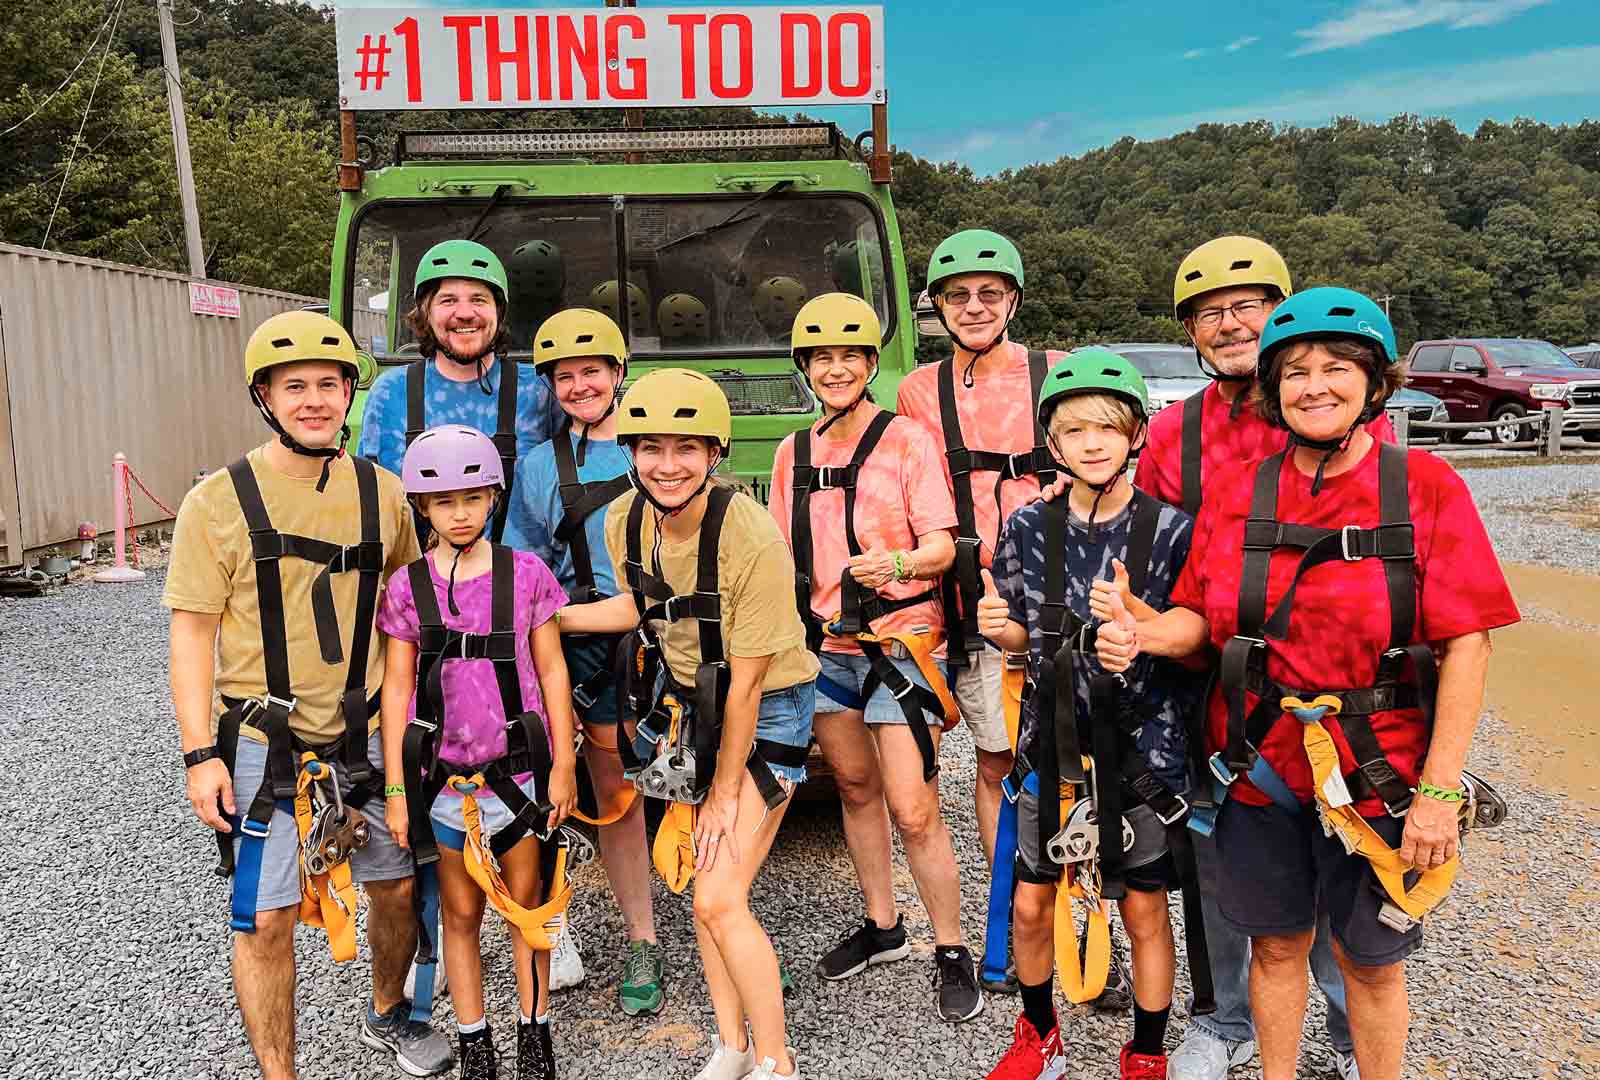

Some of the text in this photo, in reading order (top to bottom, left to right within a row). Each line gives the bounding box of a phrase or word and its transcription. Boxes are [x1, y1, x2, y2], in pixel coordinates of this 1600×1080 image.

[354, 13, 871, 102] #1 THING TO DO
